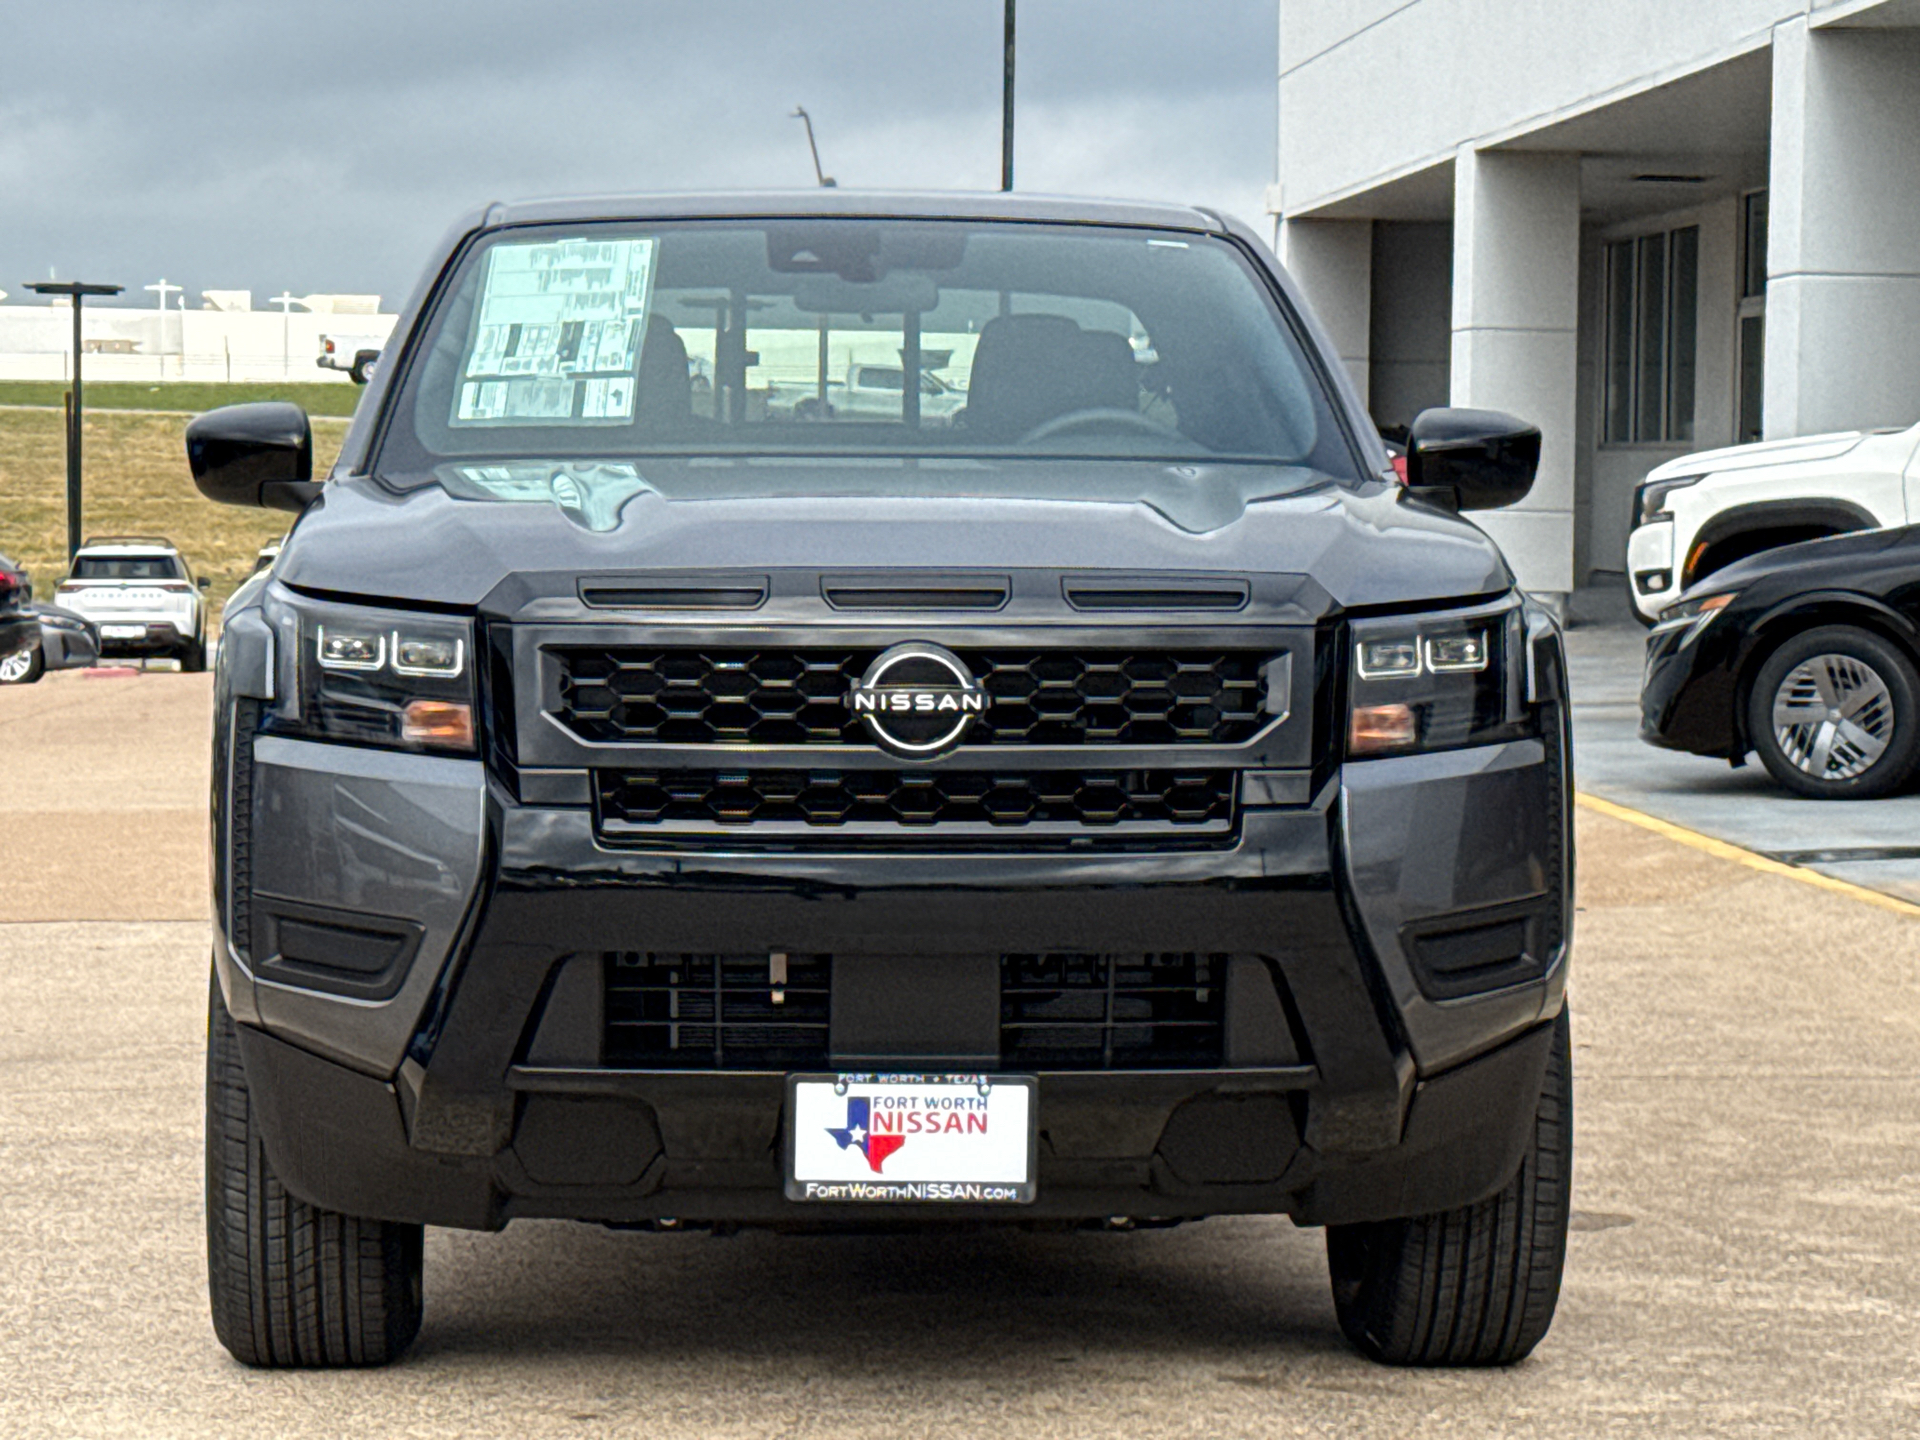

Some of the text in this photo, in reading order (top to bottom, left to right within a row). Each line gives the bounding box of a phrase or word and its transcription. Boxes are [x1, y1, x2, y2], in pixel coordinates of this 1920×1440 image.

[855, 693, 982, 711] NISSAN
[838, 1074, 989, 1084] FORT WORTH TEXAS
[873, 1097, 988, 1110] FORT WORTH
[873, 1112, 988, 1134] NISSAN
